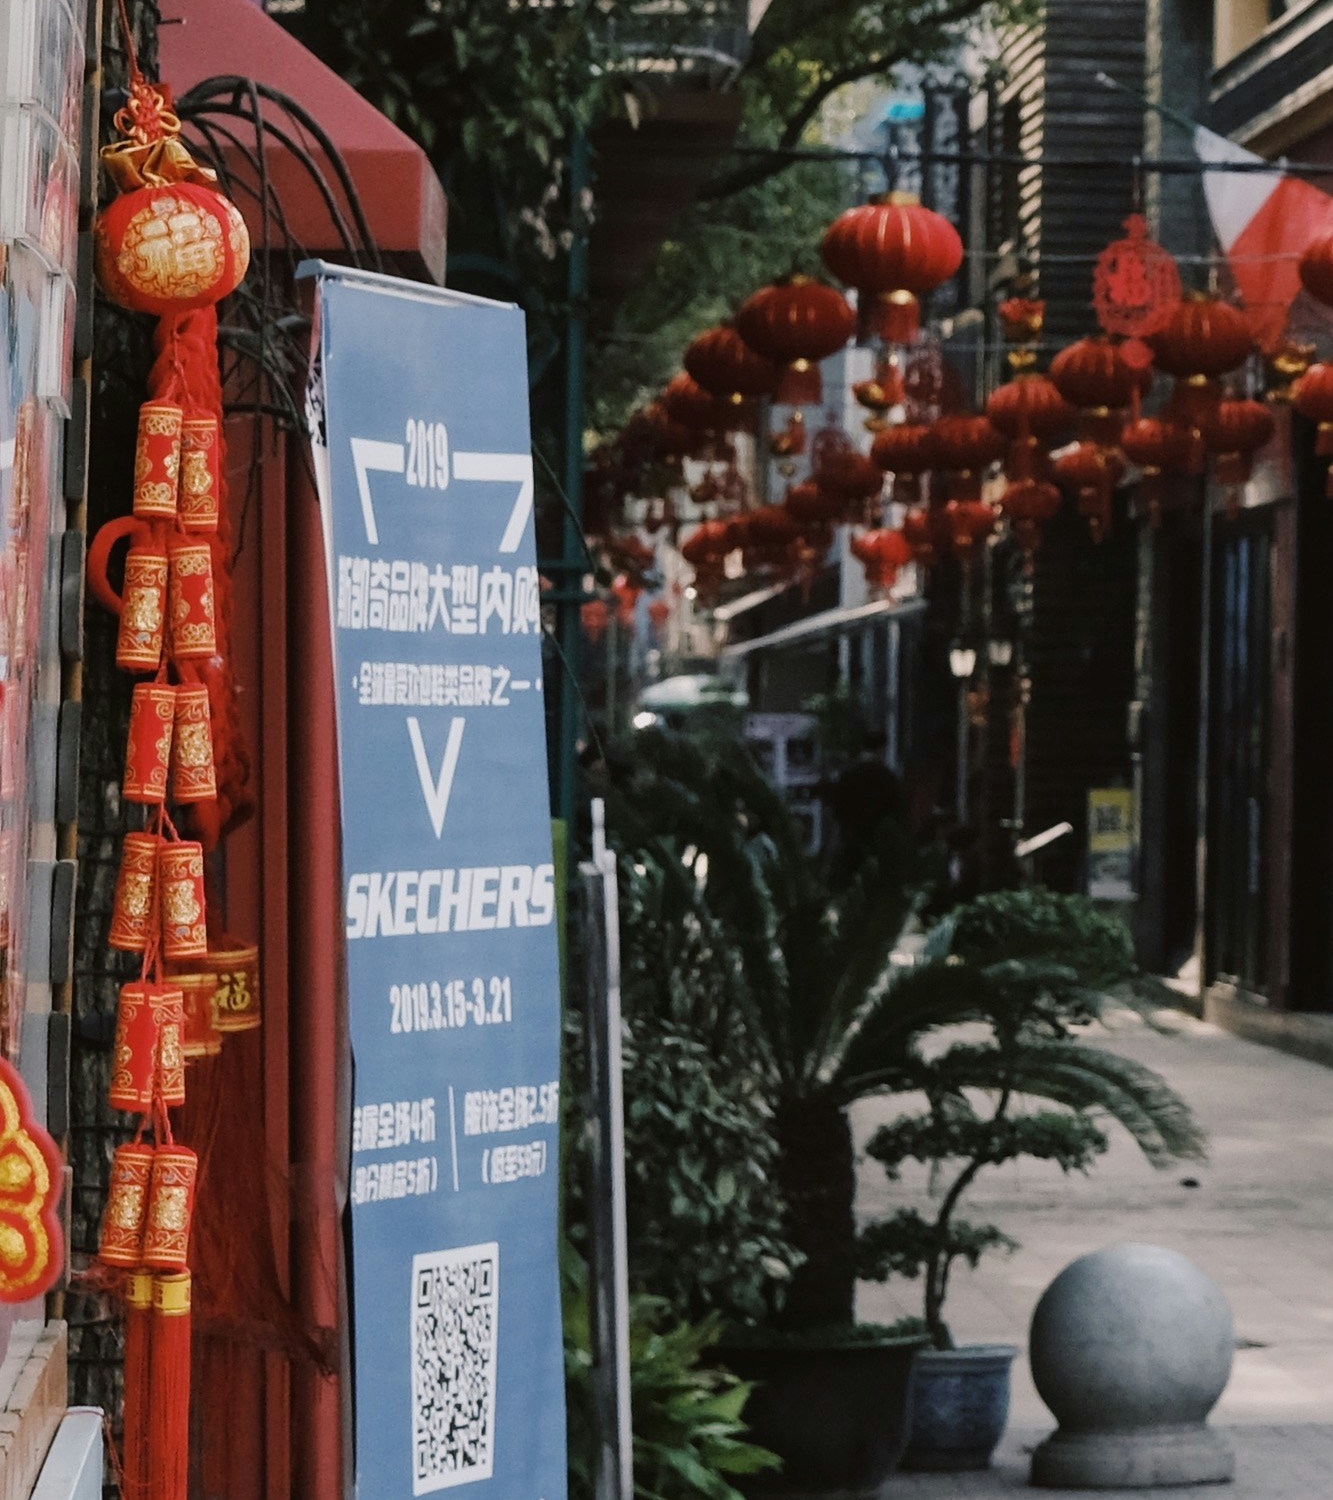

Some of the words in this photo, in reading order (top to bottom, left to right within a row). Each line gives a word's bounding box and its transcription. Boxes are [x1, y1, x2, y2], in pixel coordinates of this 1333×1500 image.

[405, 418, 449, 490] 2019
[346, 863, 555, 940] SKECHERS
[389, 975, 512, 1035] 2019.3.15-3.21
